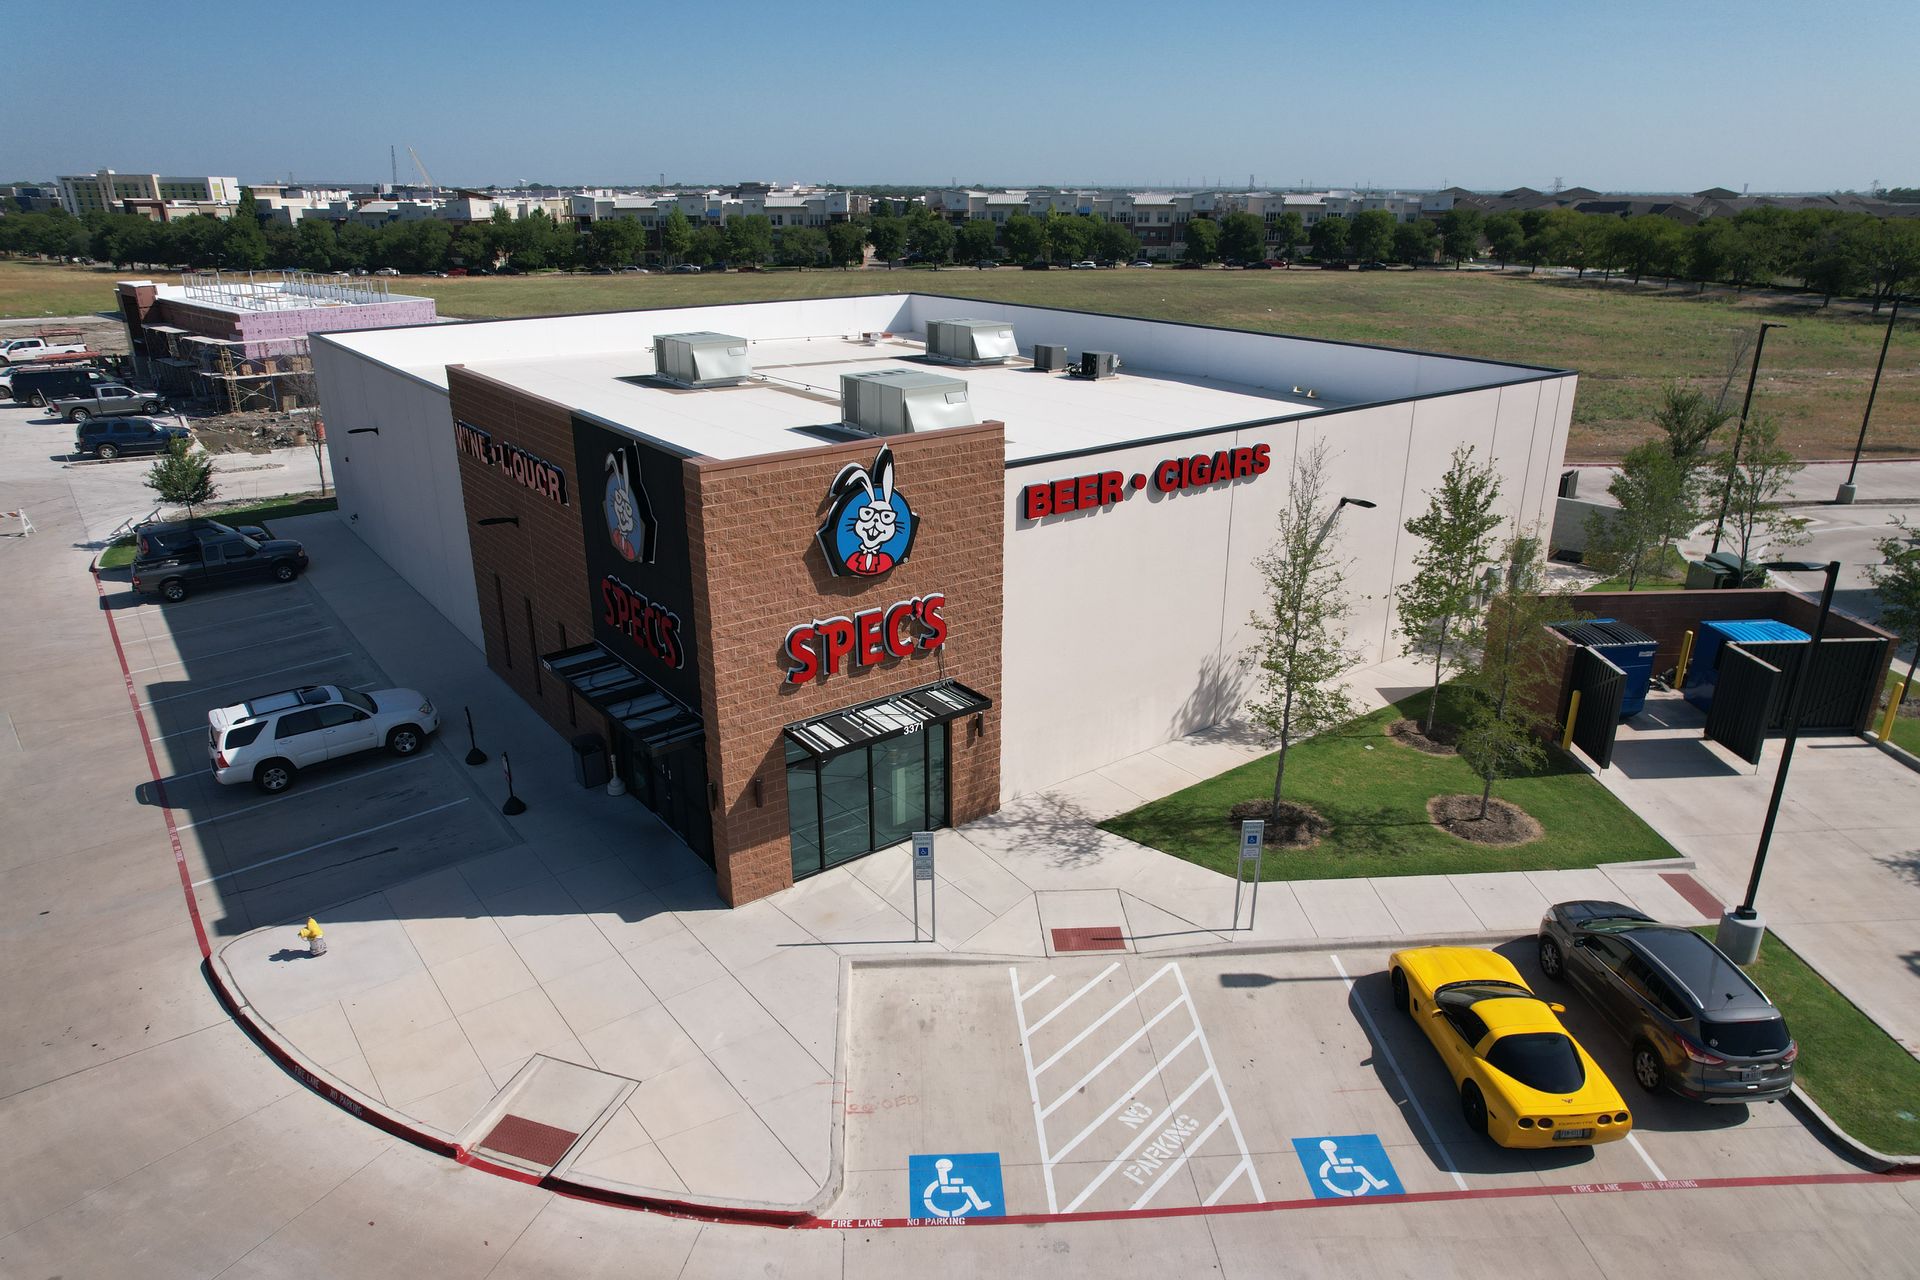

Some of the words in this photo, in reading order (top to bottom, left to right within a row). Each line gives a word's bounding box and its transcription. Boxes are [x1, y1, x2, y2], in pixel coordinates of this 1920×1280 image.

[454, 420, 491, 466] WINE
[499, 441, 568, 506] LIQUOR
[1025, 470, 1124, 520] BEER
[1155, 443, 1271, 493] CIGARS
[600, 575, 682, 669] SPEC'S
[784, 592, 948, 685] SPEC'S
[903, 721, 924, 735] 3371
[1118, 1102, 1153, 1129] NO
[1123, 1114, 1200, 1185] PARKING
[1571, 1184, 1594, 1192] FIRE
[1596, 1183, 1622, 1192] LANE
[1641, 1181, 1655, 1190] NO
[1660, 1180, 1698, 1189] PARKING
[831, 1219, 853, 1228] FIRE
[858, 1218, 883, 1227] LANE
[907, 1217, 920, 1226] NO
[925, 1217, 966, 1225] PARKING
